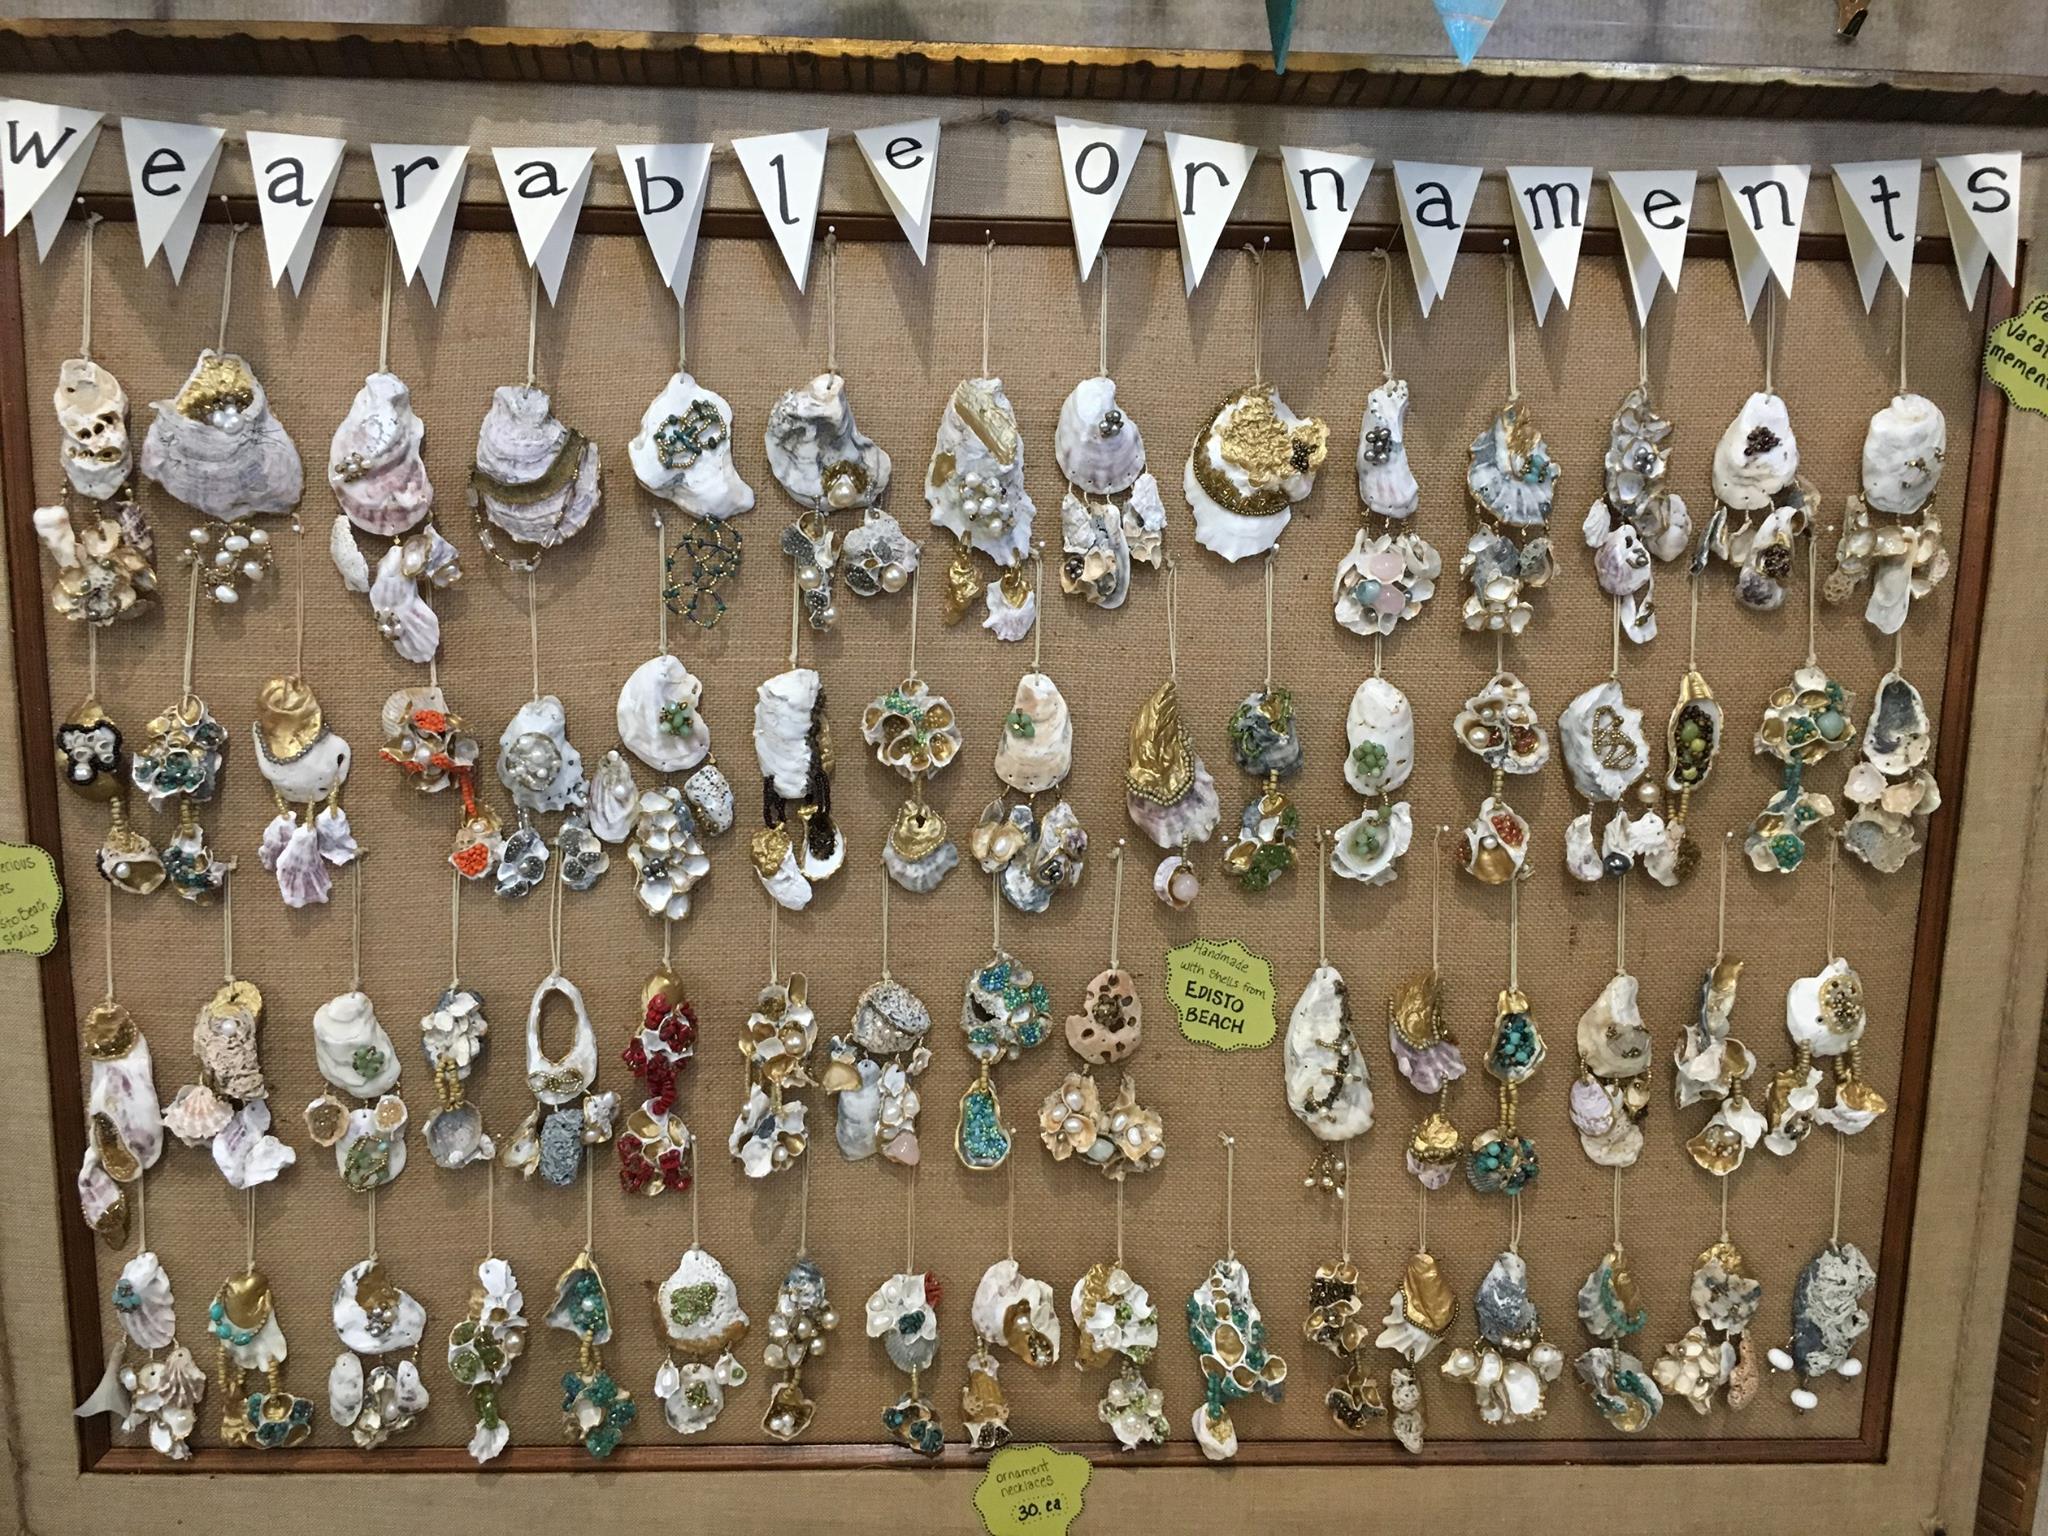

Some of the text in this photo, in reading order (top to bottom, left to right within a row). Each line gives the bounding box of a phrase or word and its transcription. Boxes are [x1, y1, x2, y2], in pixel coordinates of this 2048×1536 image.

[5, 118, 2010, 241] wearable ornaments
[1989, 344, 2048, 390] memen
[1180, 960, 1204, 976] with
[1193, 942, 1249, 973] Handmade
[1185, 980, 1245, 1013] EDISTO
[1185, 1006, 1245, 1034] BEACH
[996, 1458, 1050, 1484] ornament
[1001, 1475, 1055, 1497] necklaces
[1046, 1498, 1062, 1512] ea
